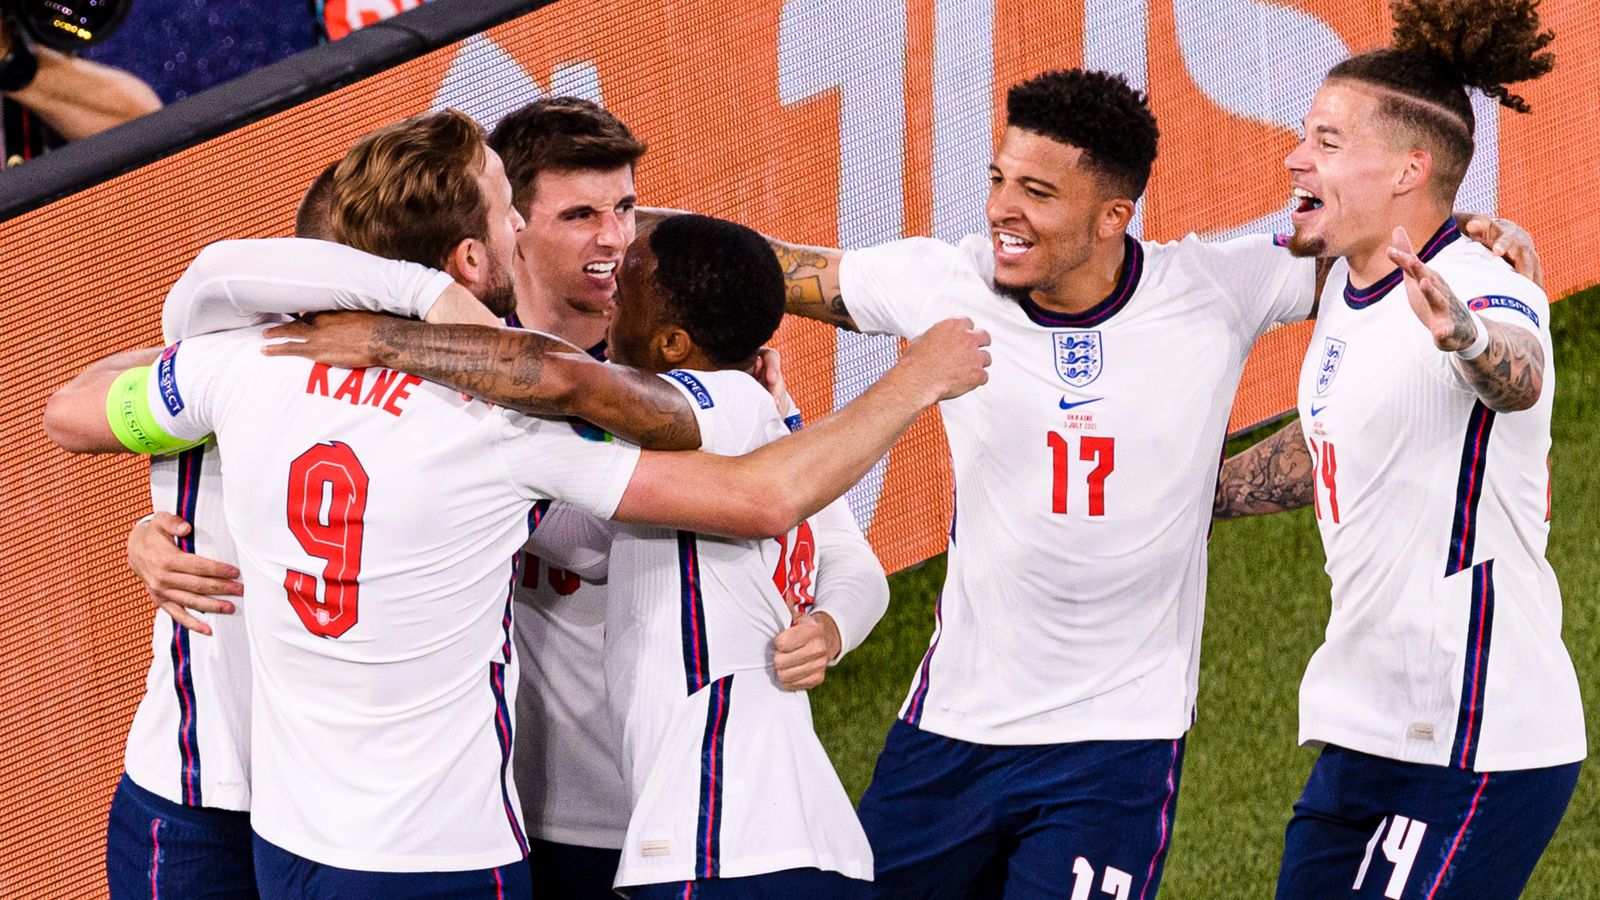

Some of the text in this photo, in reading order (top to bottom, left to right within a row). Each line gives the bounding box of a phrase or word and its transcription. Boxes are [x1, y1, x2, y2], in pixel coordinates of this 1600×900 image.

[1491, 298, 1538, 323] RESPECT
[162, 359, 180, 411] RESPECT
[306, 362, 424, 417] KANE
[670, 371, 710, 408] RESPECT
[123, 400, 163, 449] RESPEC
[1047, 430, 1115, 517] 17
[1309, 436, 1340, 525] 14
[283, 440, 370, 640] 9
[1352, 814, 1428, 900] 14
